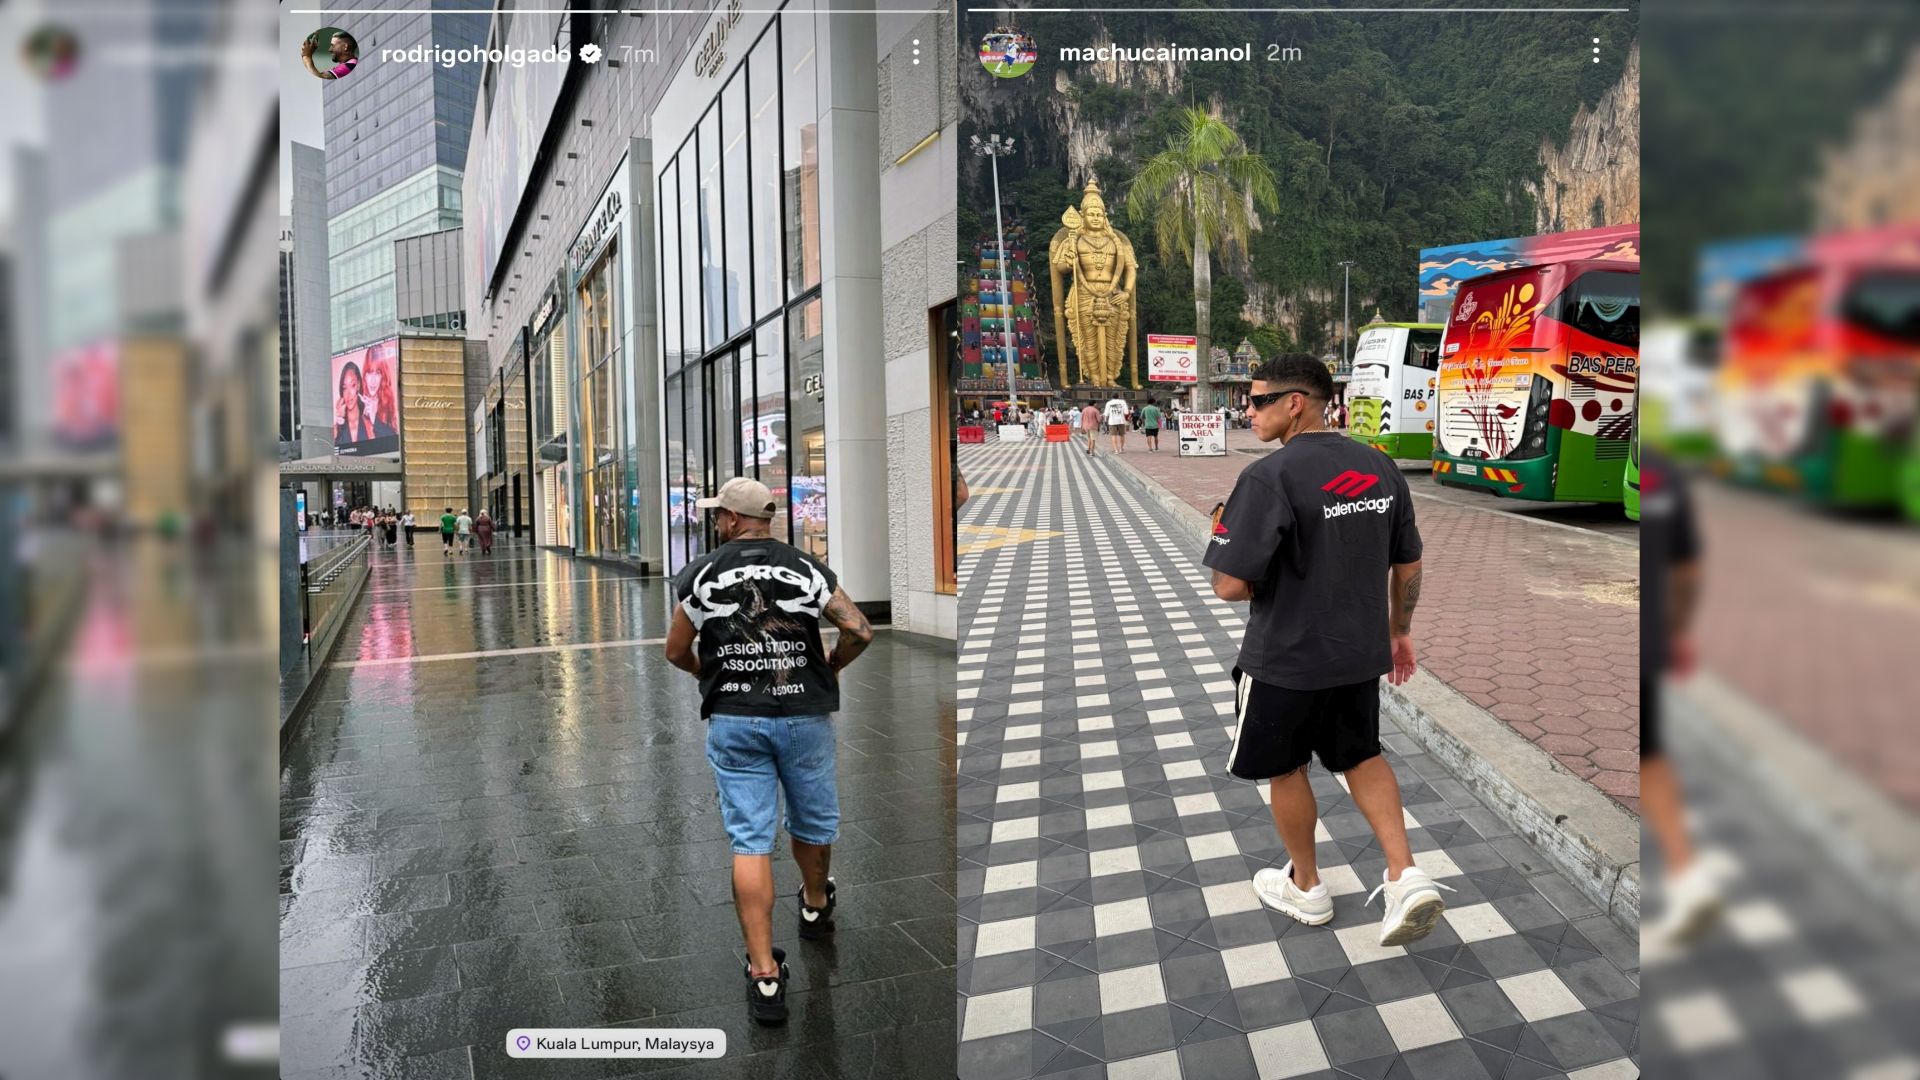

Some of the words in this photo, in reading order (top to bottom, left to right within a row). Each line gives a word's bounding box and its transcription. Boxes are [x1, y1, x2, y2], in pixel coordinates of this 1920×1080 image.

[1568, 357, 1601, 373] BAS
[1604, 357, 1637, 374] PER
[1403, 389, 1424, 400] BAS
[414, 397, 455, 409] Cartier
[1190, 429, 1214, 437] AREA
